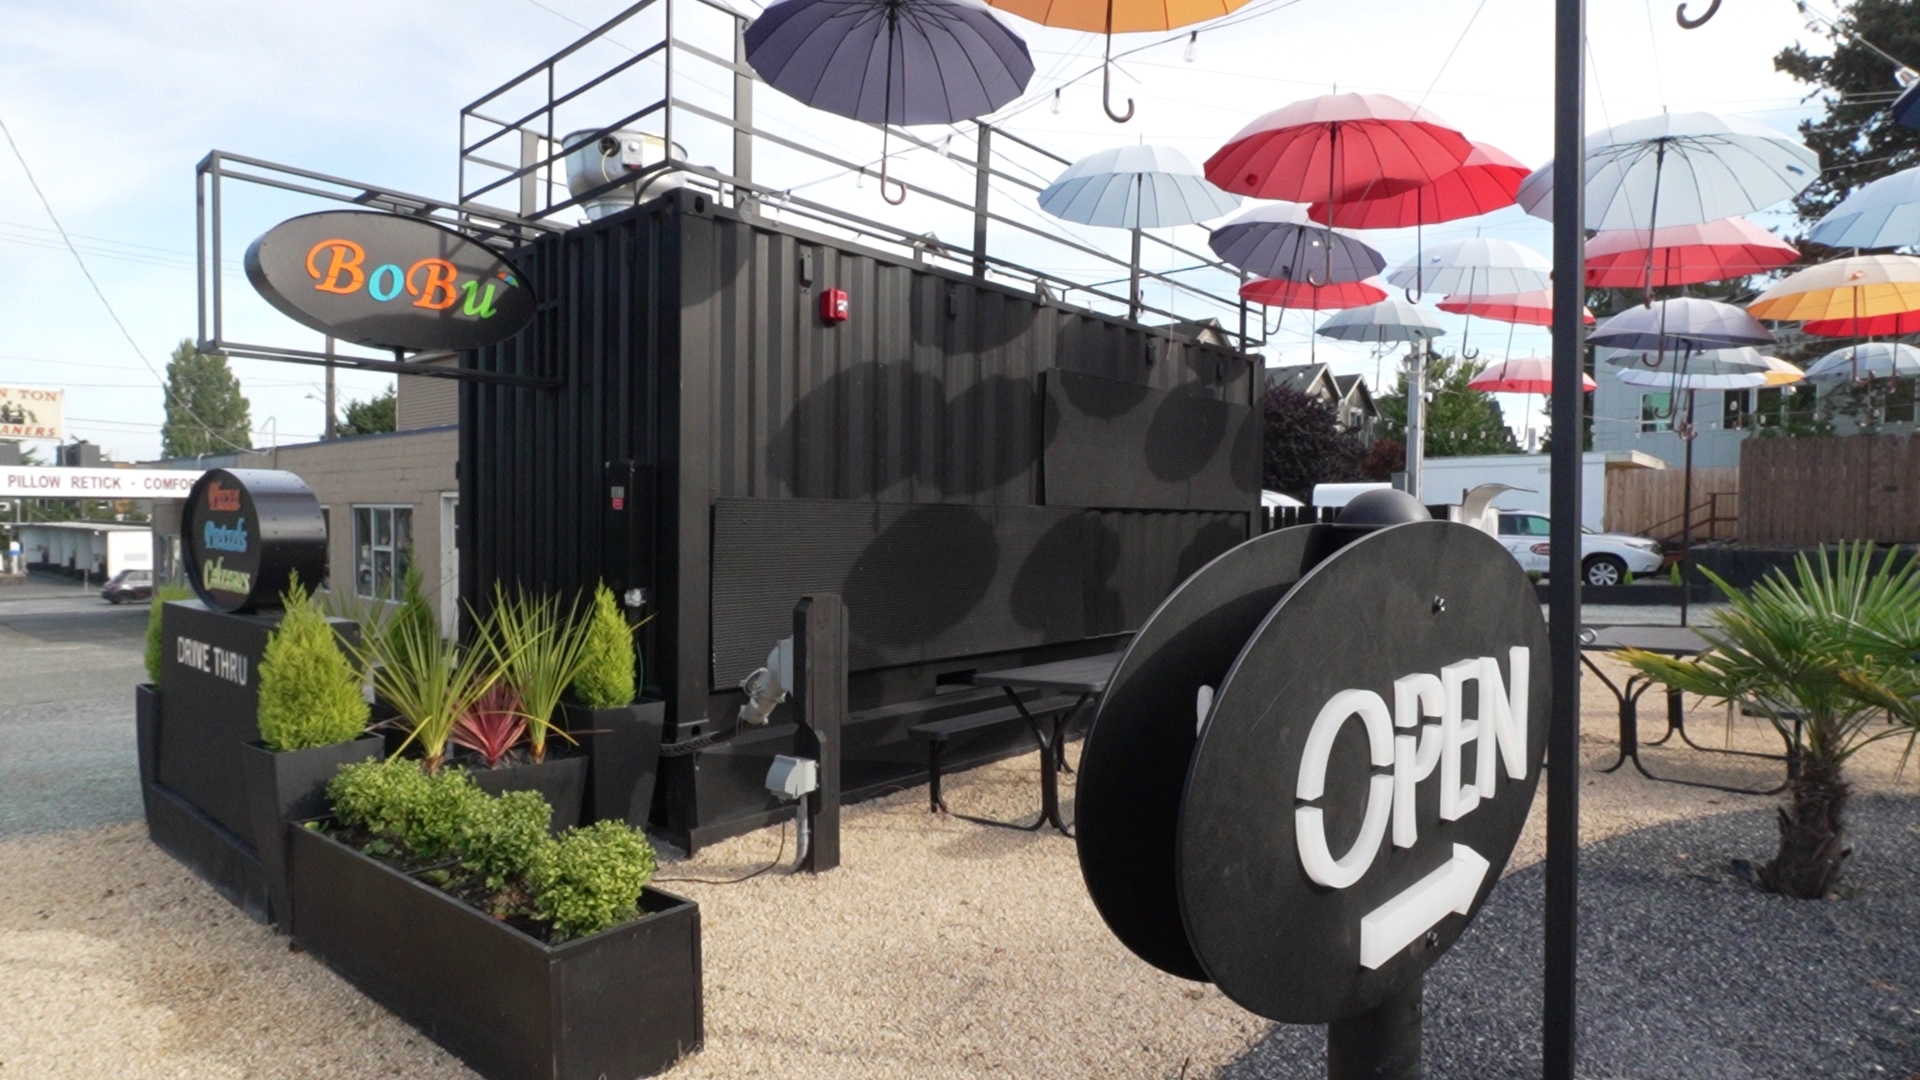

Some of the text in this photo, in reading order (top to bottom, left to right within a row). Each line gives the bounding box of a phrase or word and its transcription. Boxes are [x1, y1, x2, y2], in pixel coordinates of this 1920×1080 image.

[305, 238, 497, 319] BoBu
[18, 389, 58, 401] TON
[8, 474, 61, 489] PILLOW
[71, 476, 122, 490] RETICK
[177, 635, 249, 686] DRIVE THRU
[1295, 646, 1530, 889] OPEN
